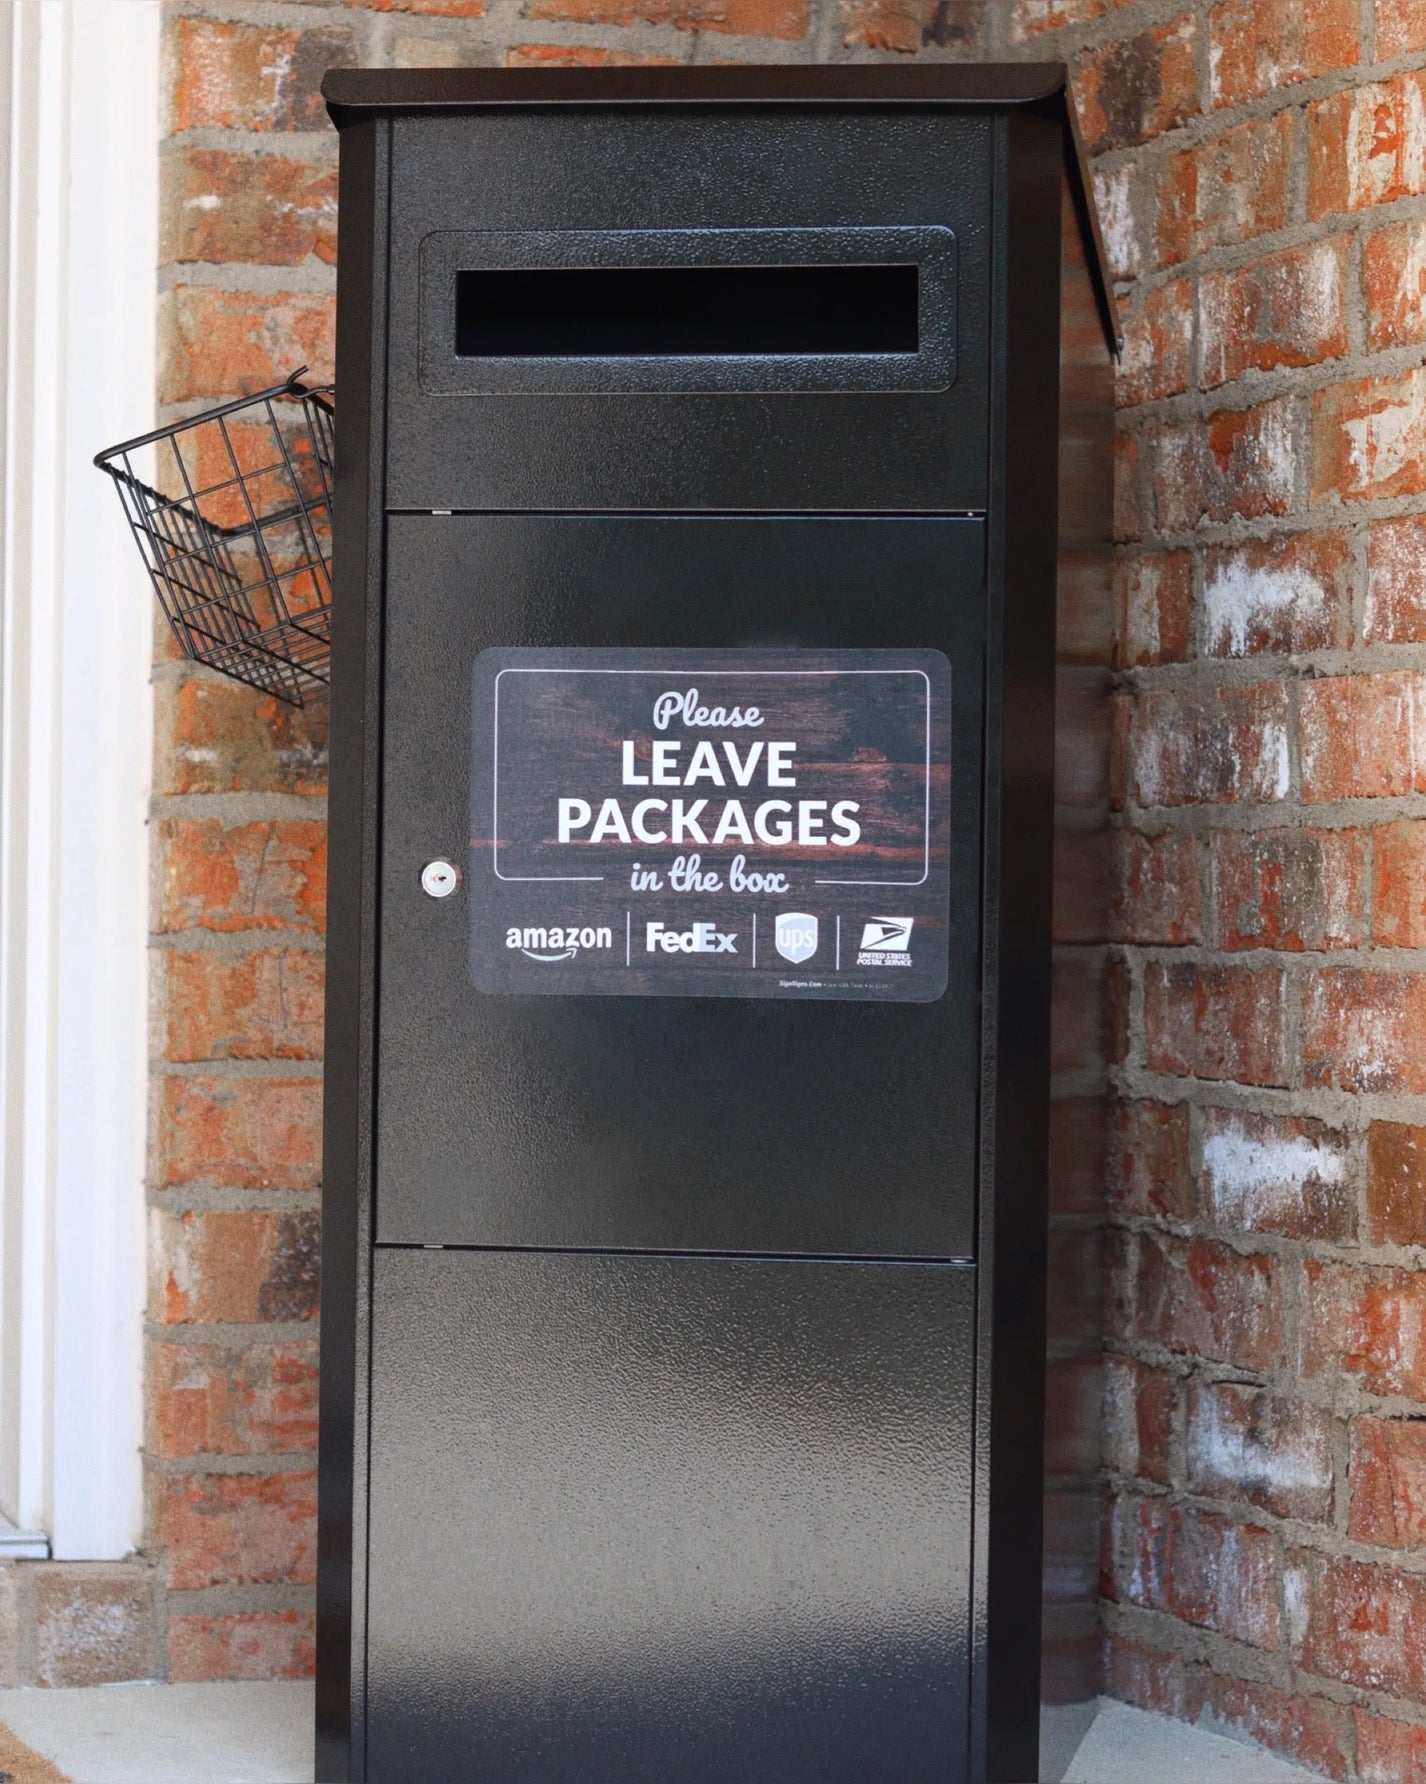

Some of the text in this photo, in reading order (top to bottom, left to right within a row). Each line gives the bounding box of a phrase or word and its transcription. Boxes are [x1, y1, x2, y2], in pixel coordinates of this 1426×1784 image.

[653, 688, 764, 730] Please
[623, 741, 796, 787] LEAVE
[558, 799, 861, 846] PACKAGES
[631, 854, 789, 893] in the box
[506, 927, 612, 949] amazon
[646, 922, 738, 953] FedEx
[779, 928, 815, 955] ups
